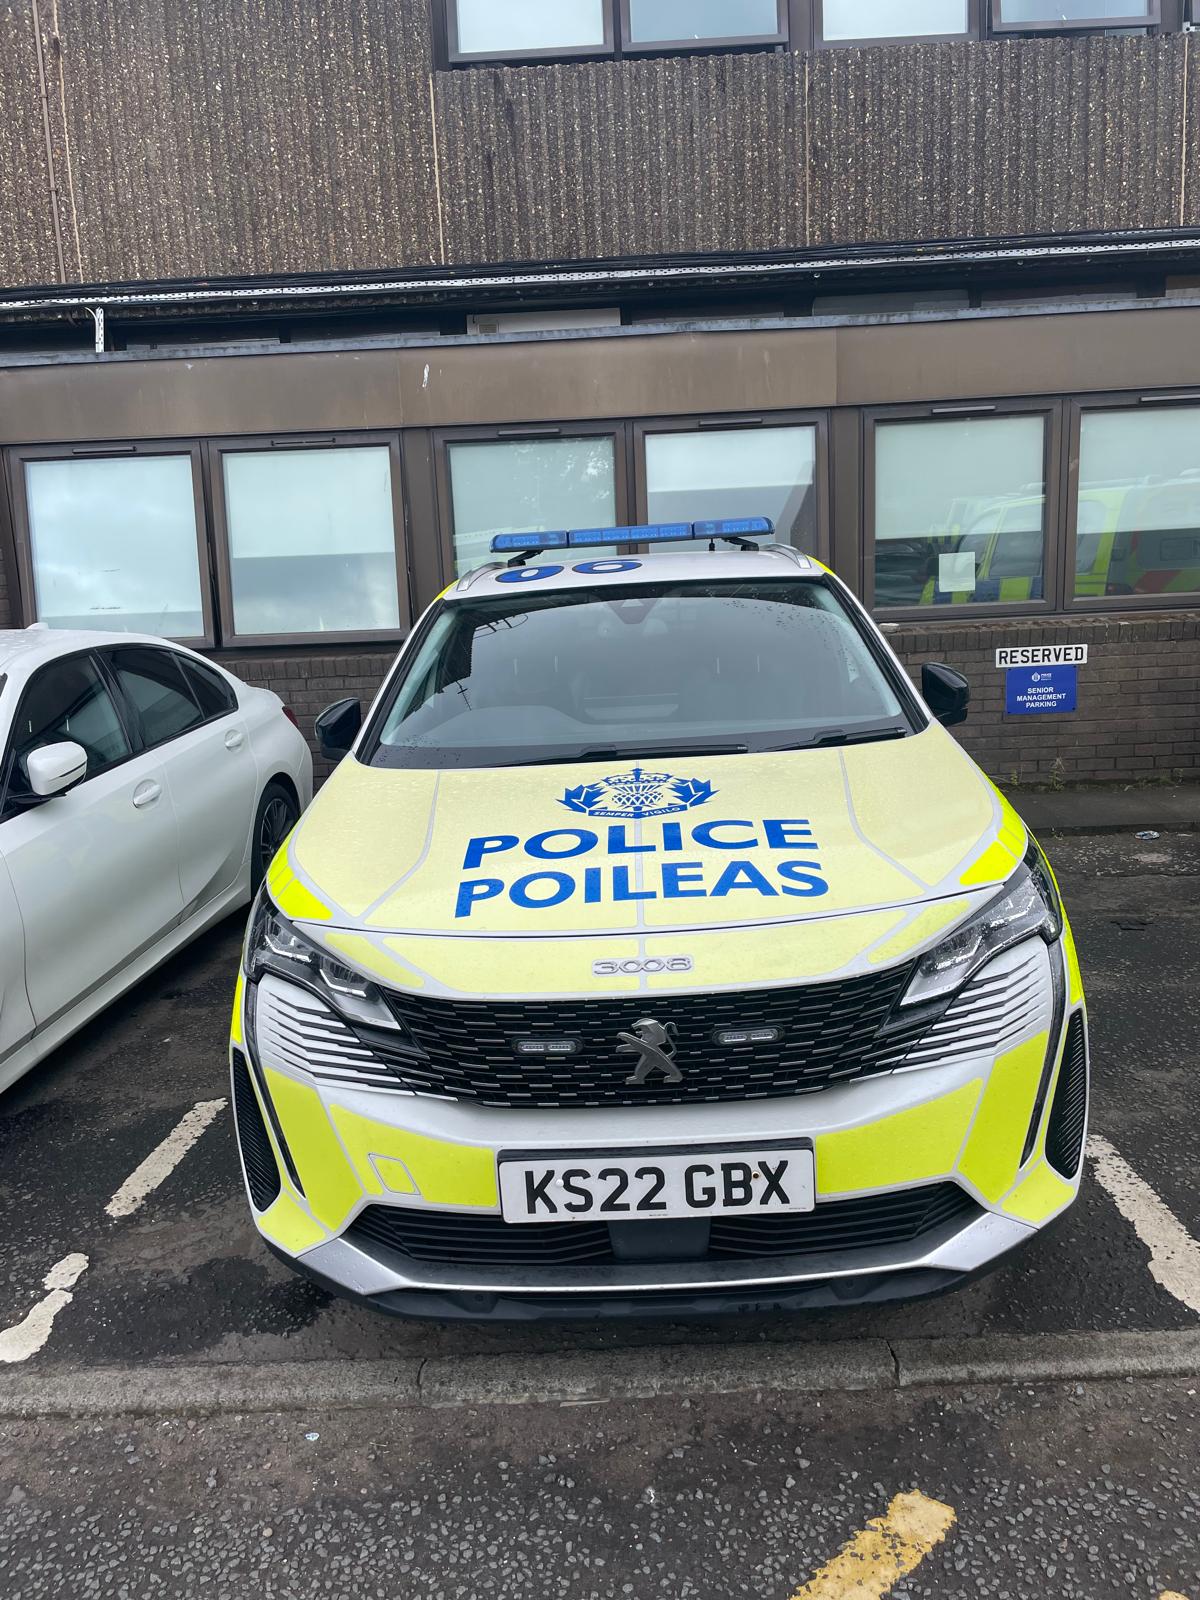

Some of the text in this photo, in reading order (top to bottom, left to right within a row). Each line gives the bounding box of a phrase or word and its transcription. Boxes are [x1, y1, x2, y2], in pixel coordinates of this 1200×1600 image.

[998, 646, 1084, 665] RESERVED
[1016, 693, 1067, 702] MANAGEMENT
[1027, 686, 1054, 694] SENIOR
[1025, 700, 1057, 709] PARKING
[462, 818, 820, 870] POLICE
[454, 860, 830, 918] POILEAS
[593, 957, 692, 975] 3008
[524, 1159, 791, 1215] KS22 GBX
